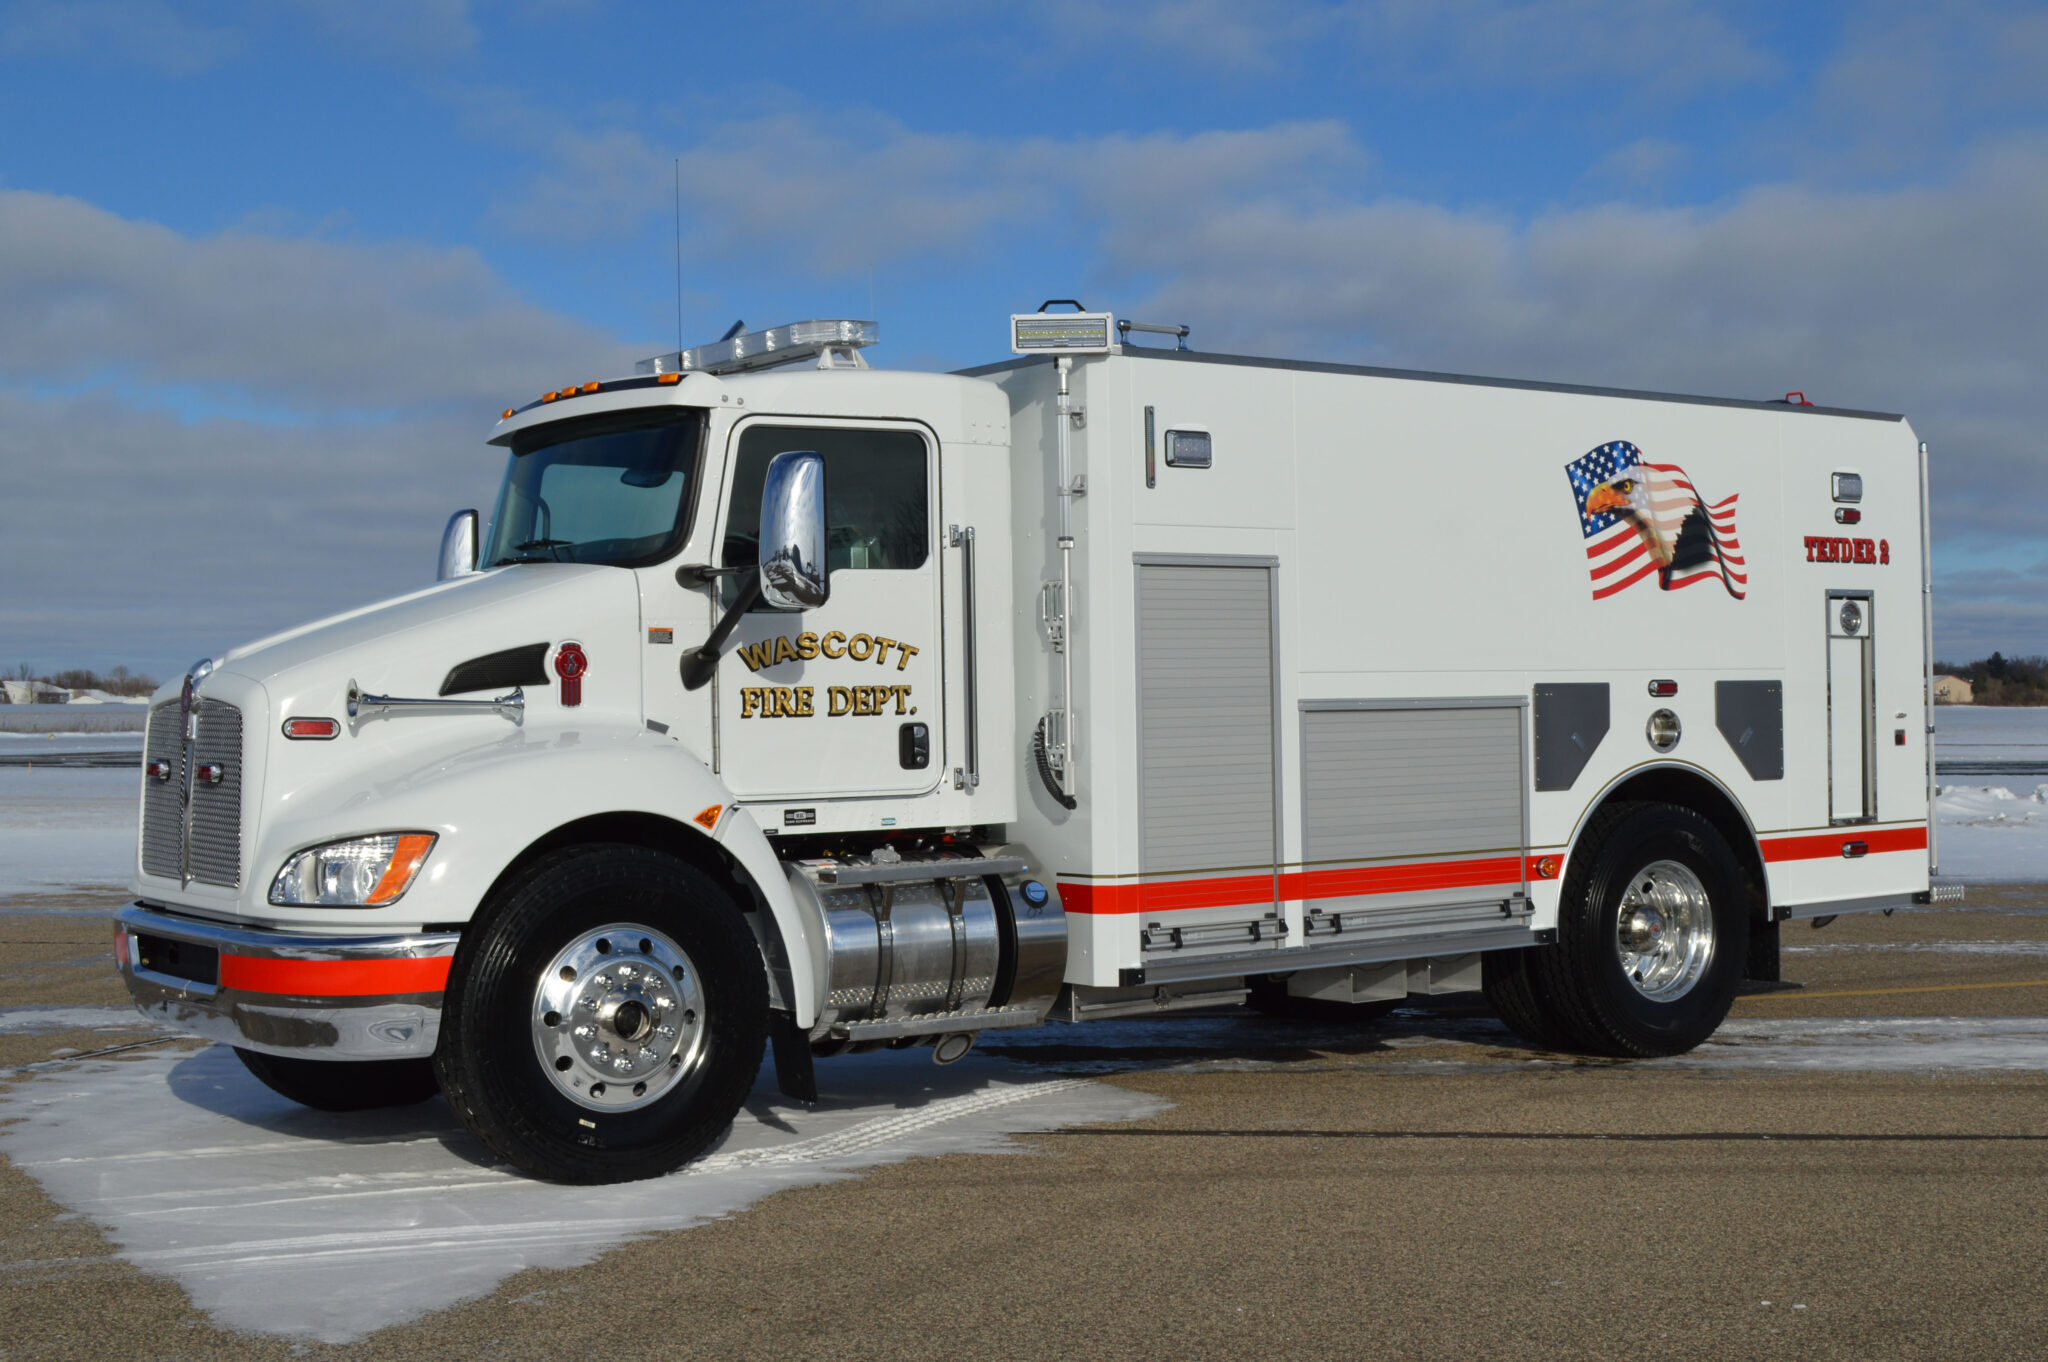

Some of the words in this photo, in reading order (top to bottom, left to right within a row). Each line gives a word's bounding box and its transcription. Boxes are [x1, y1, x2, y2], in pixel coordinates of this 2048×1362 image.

[1804, 536, 1877, 565] TENDER
[1879, 538, 1890, 565] 2
[737, 631, 919, 672] WASCOTT
[741, 686, 814, 719] FIRE
[828, 685, 917, 717] DEPT.
